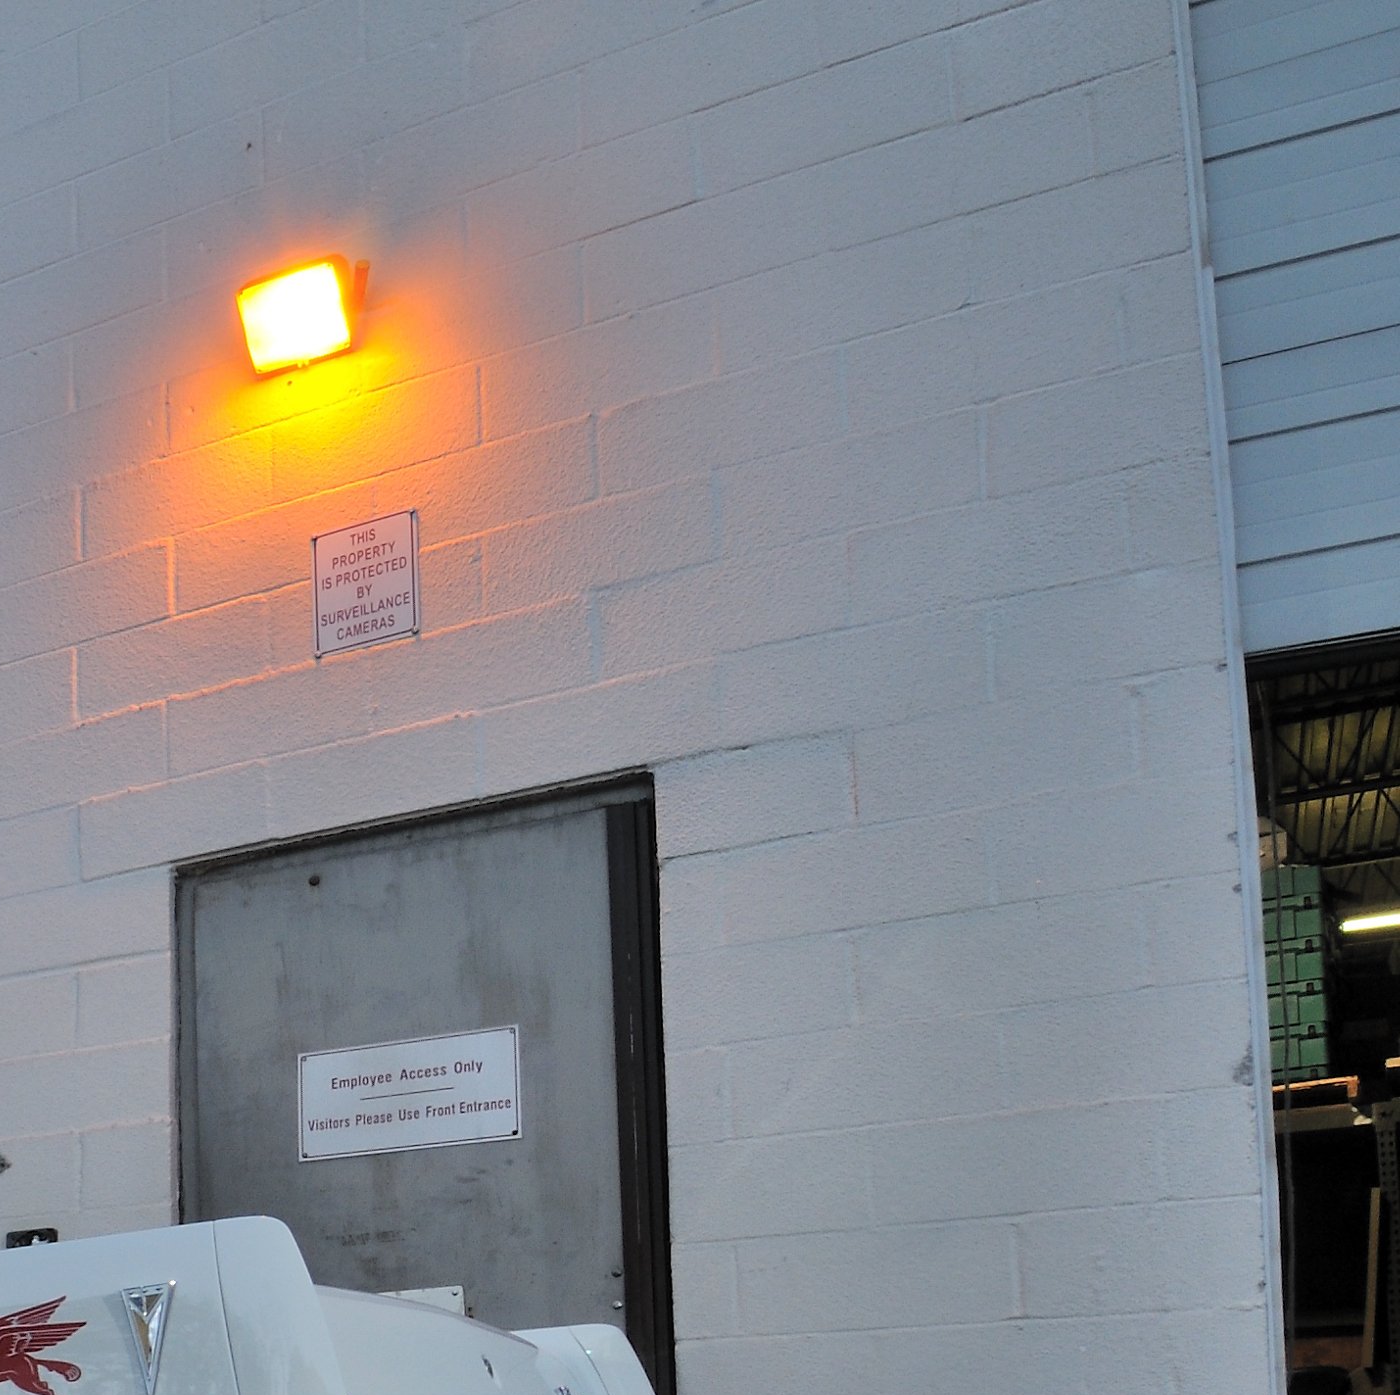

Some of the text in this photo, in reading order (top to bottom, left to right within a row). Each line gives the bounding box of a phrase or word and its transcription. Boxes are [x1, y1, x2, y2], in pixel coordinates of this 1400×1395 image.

[350, 528, 376, 546] THIS
[332, 541, 396, 570] PROPERTY
[321, 556, 407, 591] IS PROTECTED
[357, 584, 373, 599] BY
[320, 591, 410, 627] SURVEILLANCE
[337, 614, 395, 641] CAMERAS
[331, 1060, 483, 1090] Employee Access Only
[307, 1098, 512, 1132] Visitors Please Use Front Entrance
